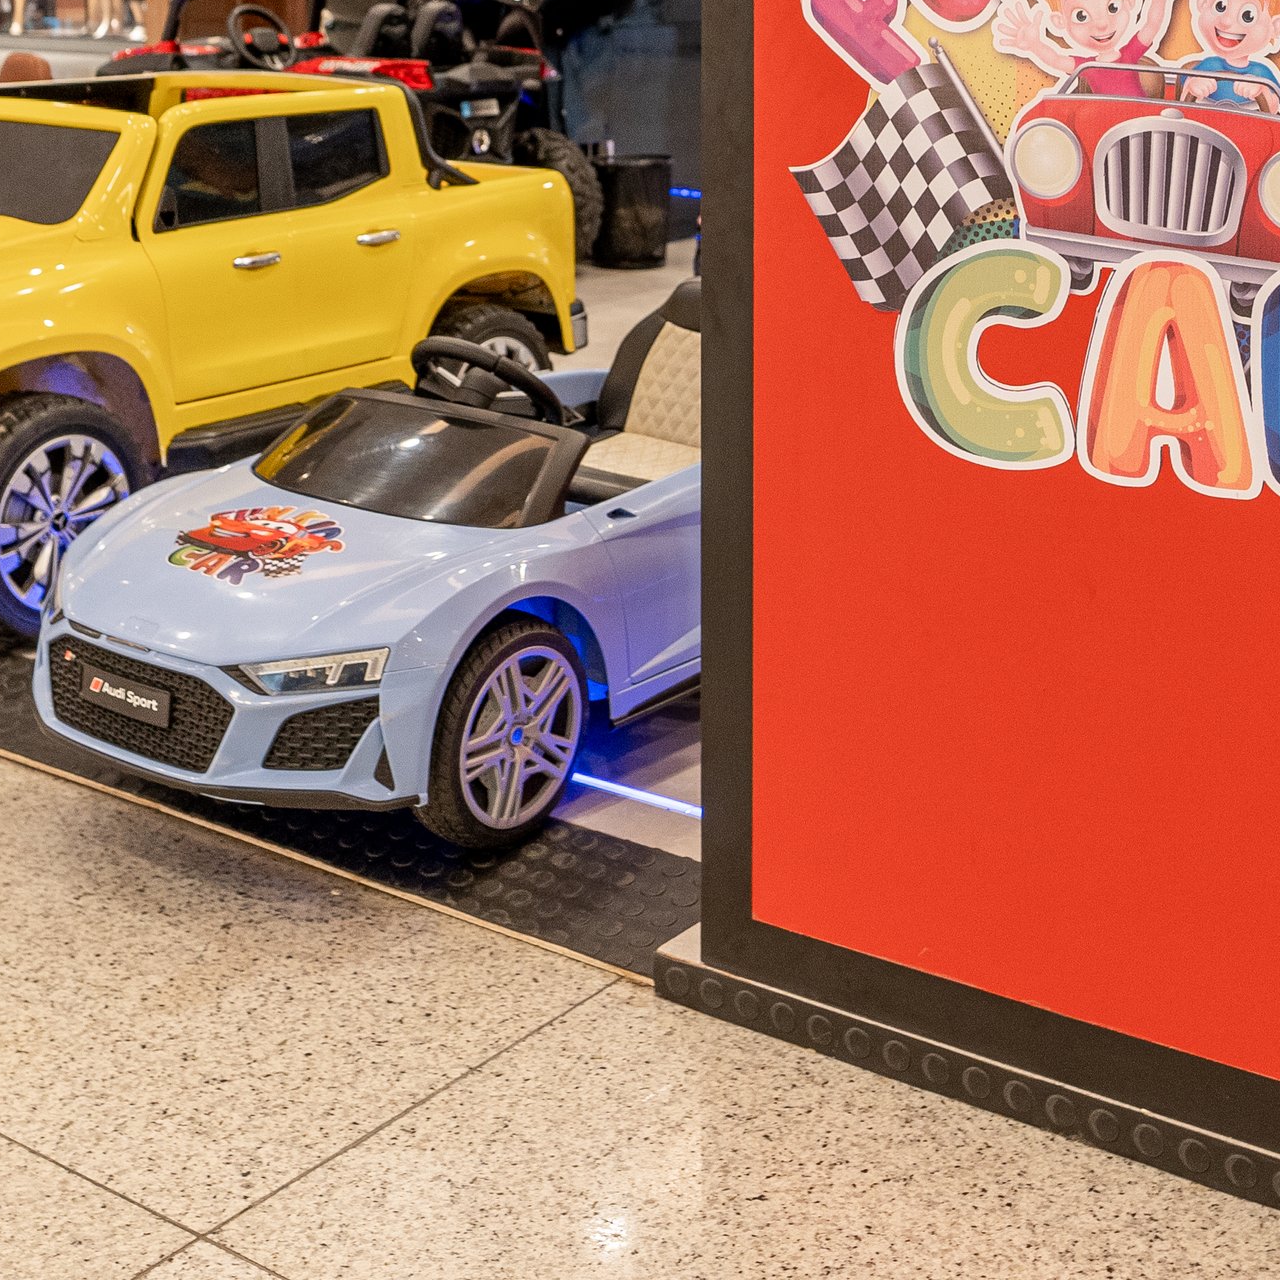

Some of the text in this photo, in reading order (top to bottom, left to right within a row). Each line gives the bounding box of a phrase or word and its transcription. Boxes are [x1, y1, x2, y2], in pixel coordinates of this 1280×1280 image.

[167, 544, 264, 587] CAR
[101, 681, 159, 712] Audi Sport
